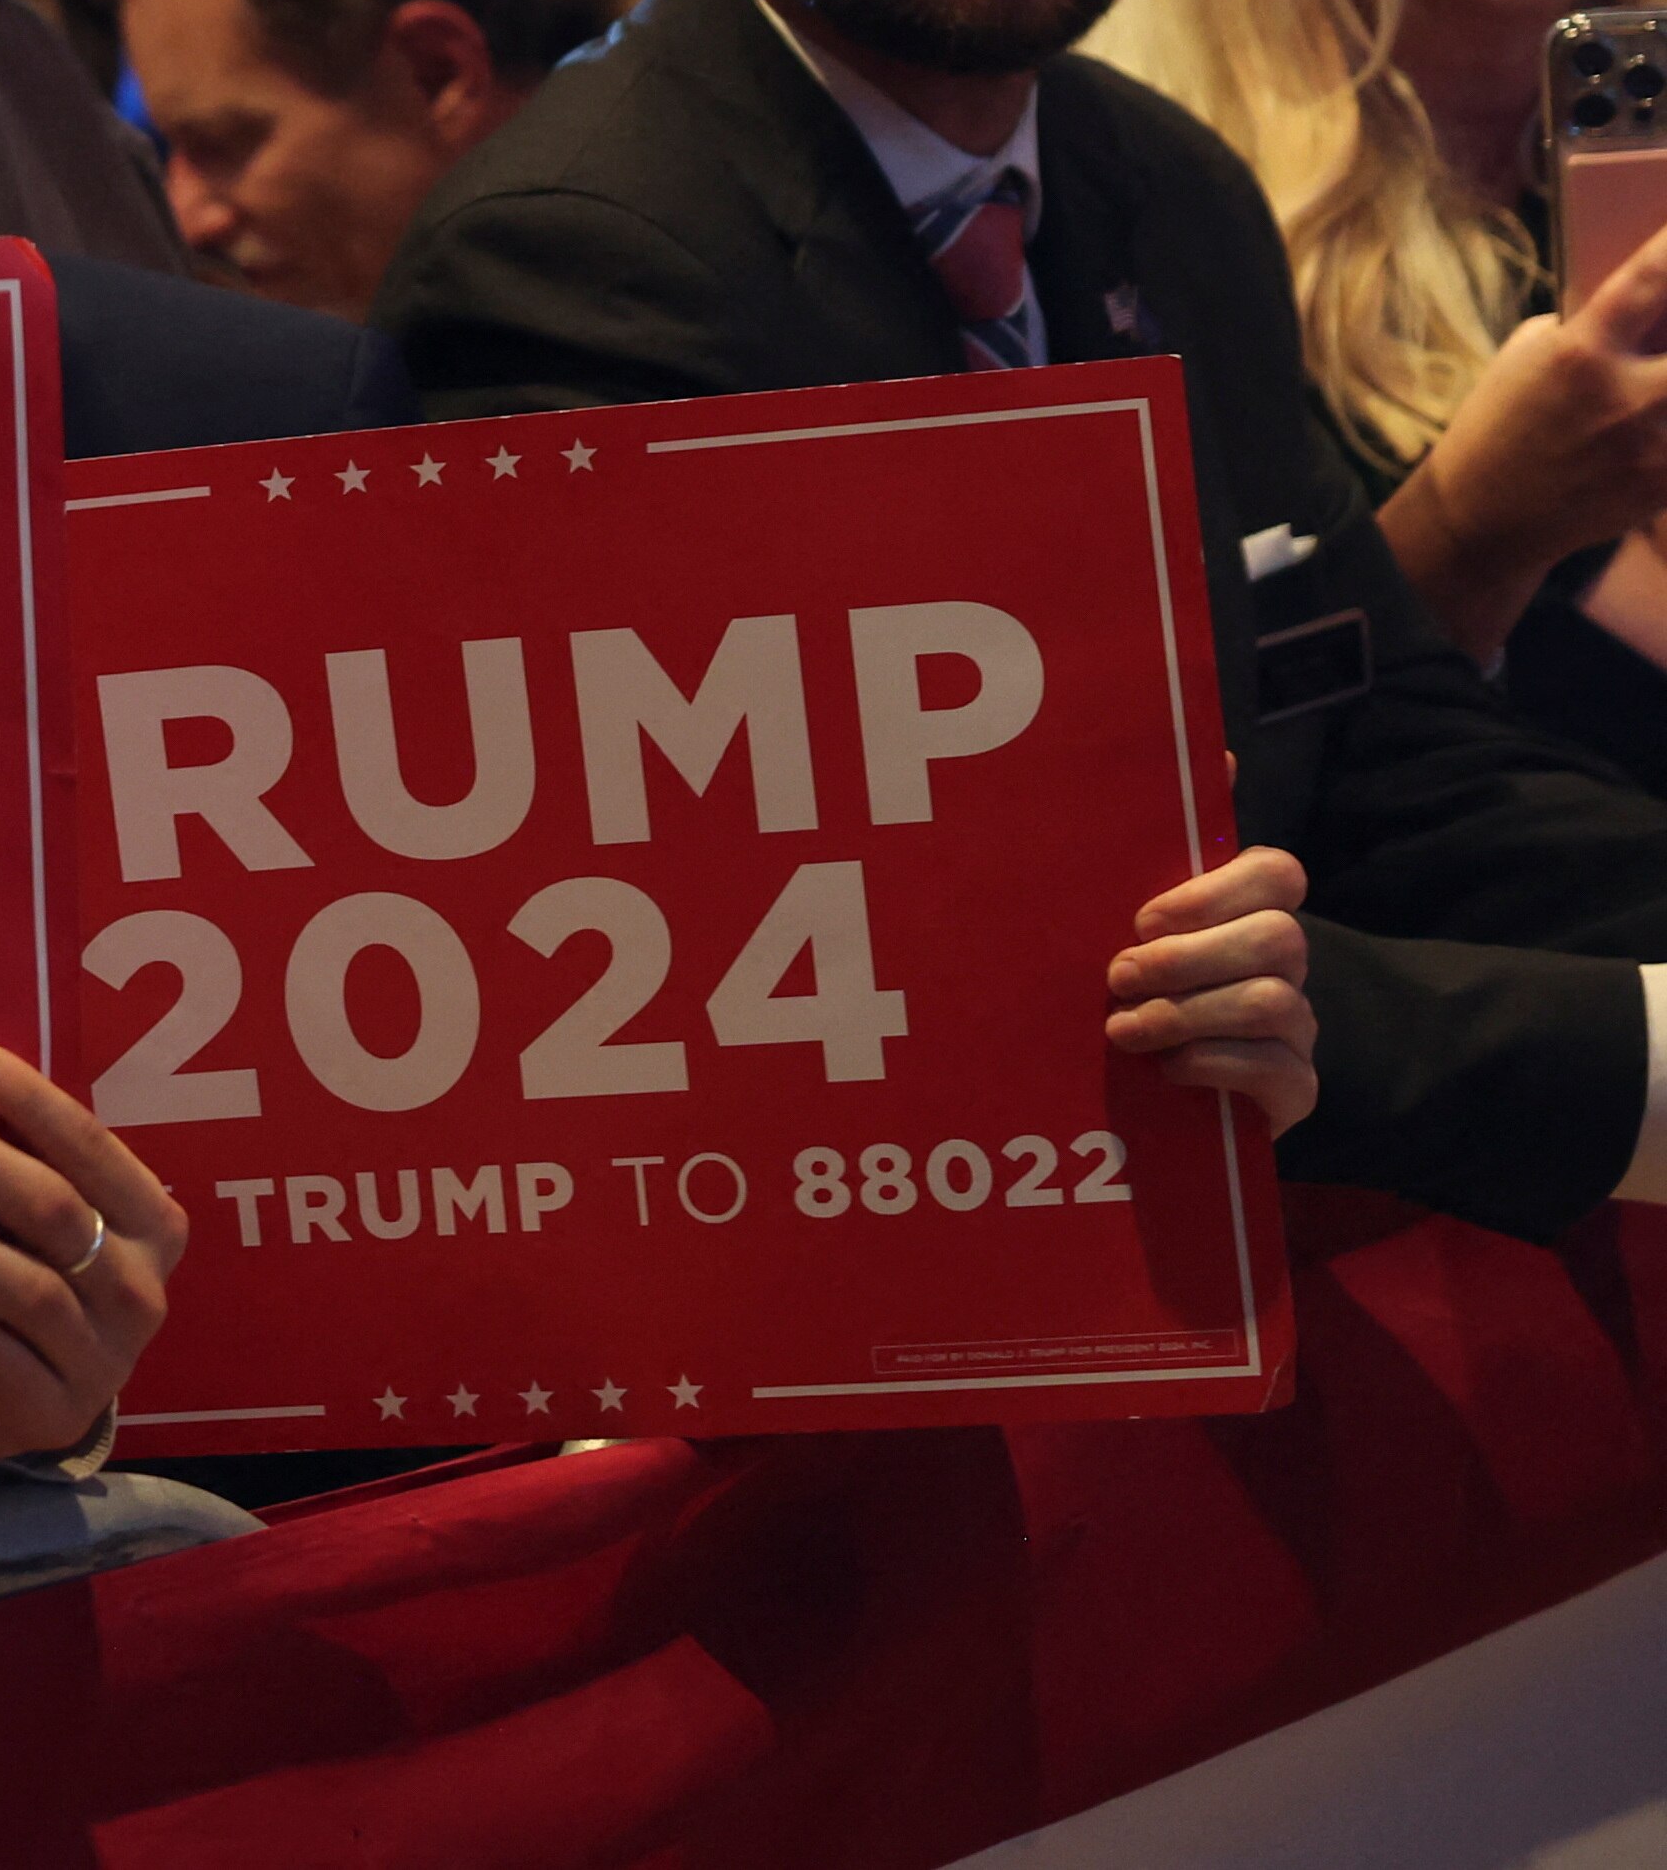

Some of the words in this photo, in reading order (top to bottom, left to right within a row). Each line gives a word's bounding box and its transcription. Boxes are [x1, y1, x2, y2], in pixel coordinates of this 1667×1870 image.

[96, 601, 1044, 883] RUMP
[82, 860, 908, 1127] 2024
[216, 1162, 573, 1247] TRUMP
[612, 1152, 746, 1226] TO
[794, 1130, 1131, 1218] 88022
